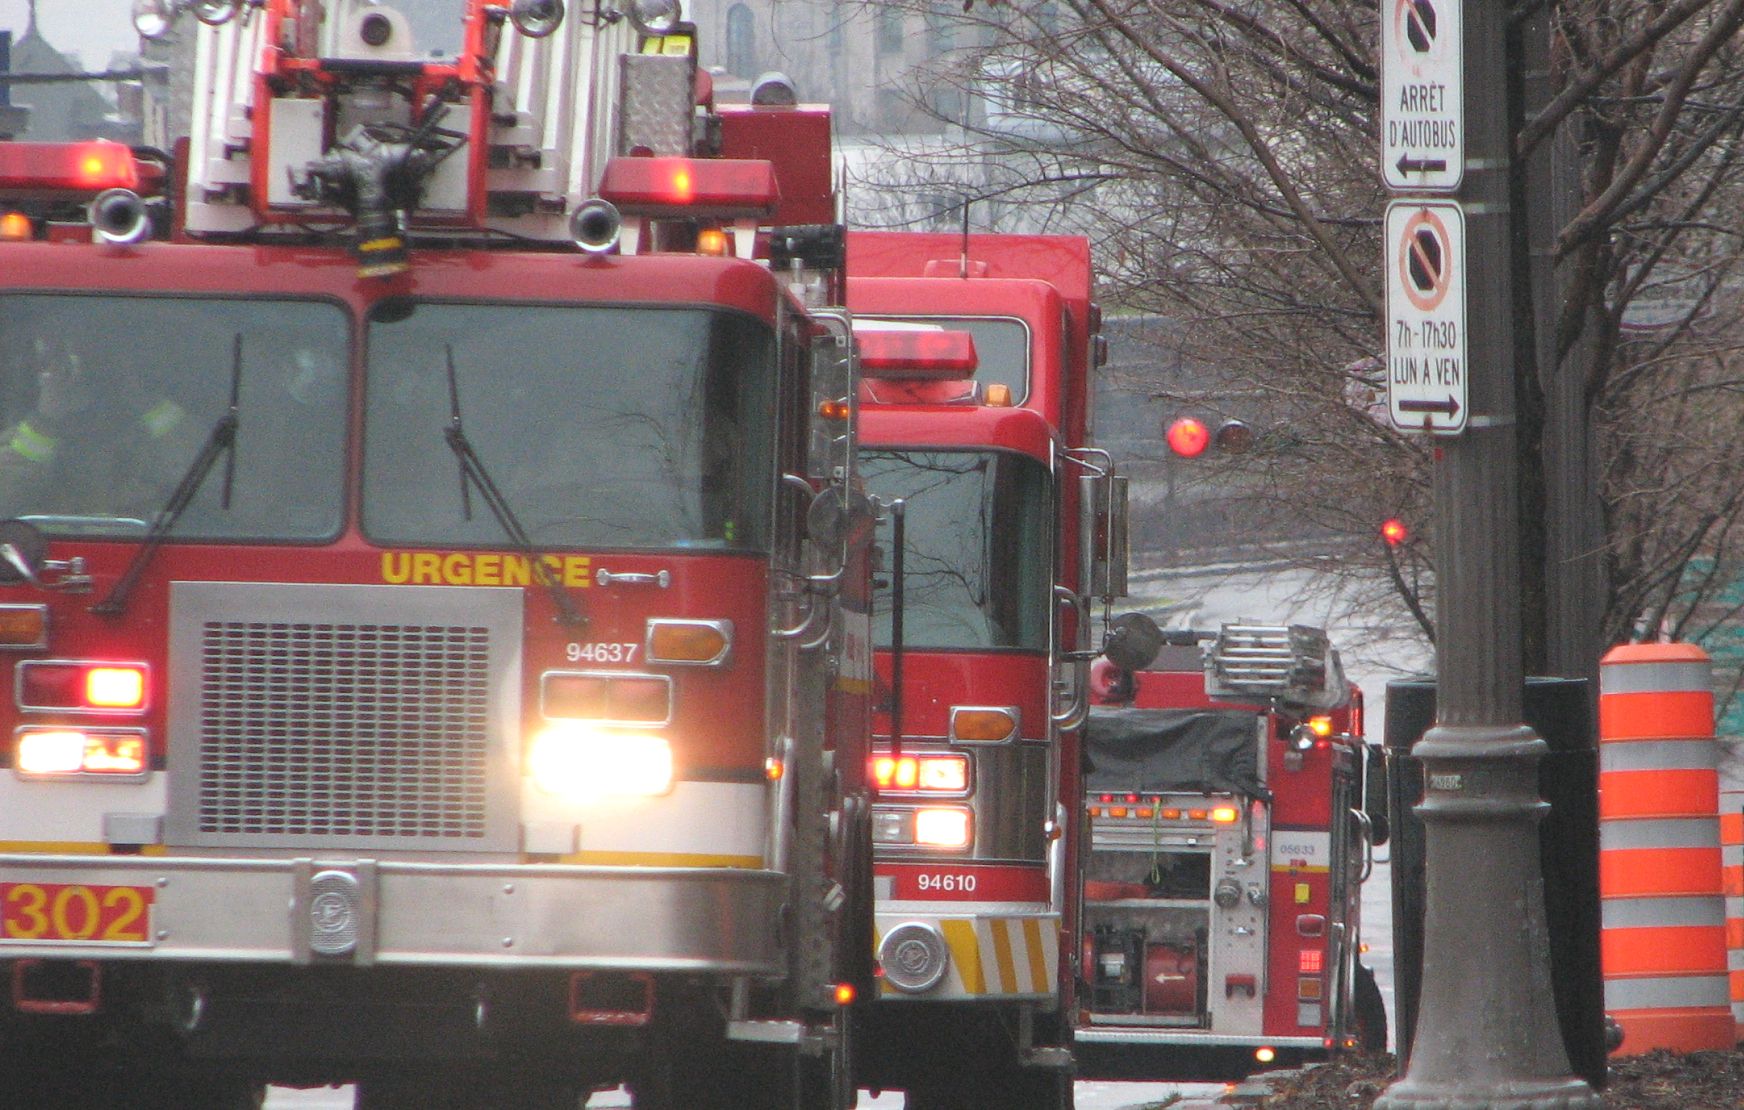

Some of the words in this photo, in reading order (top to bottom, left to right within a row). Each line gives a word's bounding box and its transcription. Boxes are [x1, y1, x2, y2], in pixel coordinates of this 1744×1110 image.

[1390, 120, 1456, 148] D'AUTOBUS
[1394, 357, 1417, 384] LUN
[1435, 357, 1459, 386] VEN
[382, 552, 591, 588] URGENCE
[566, 643, 638, 662] 94637
[918, 874, 976, 891] 94610
[5, 884, 145, 941] 302
